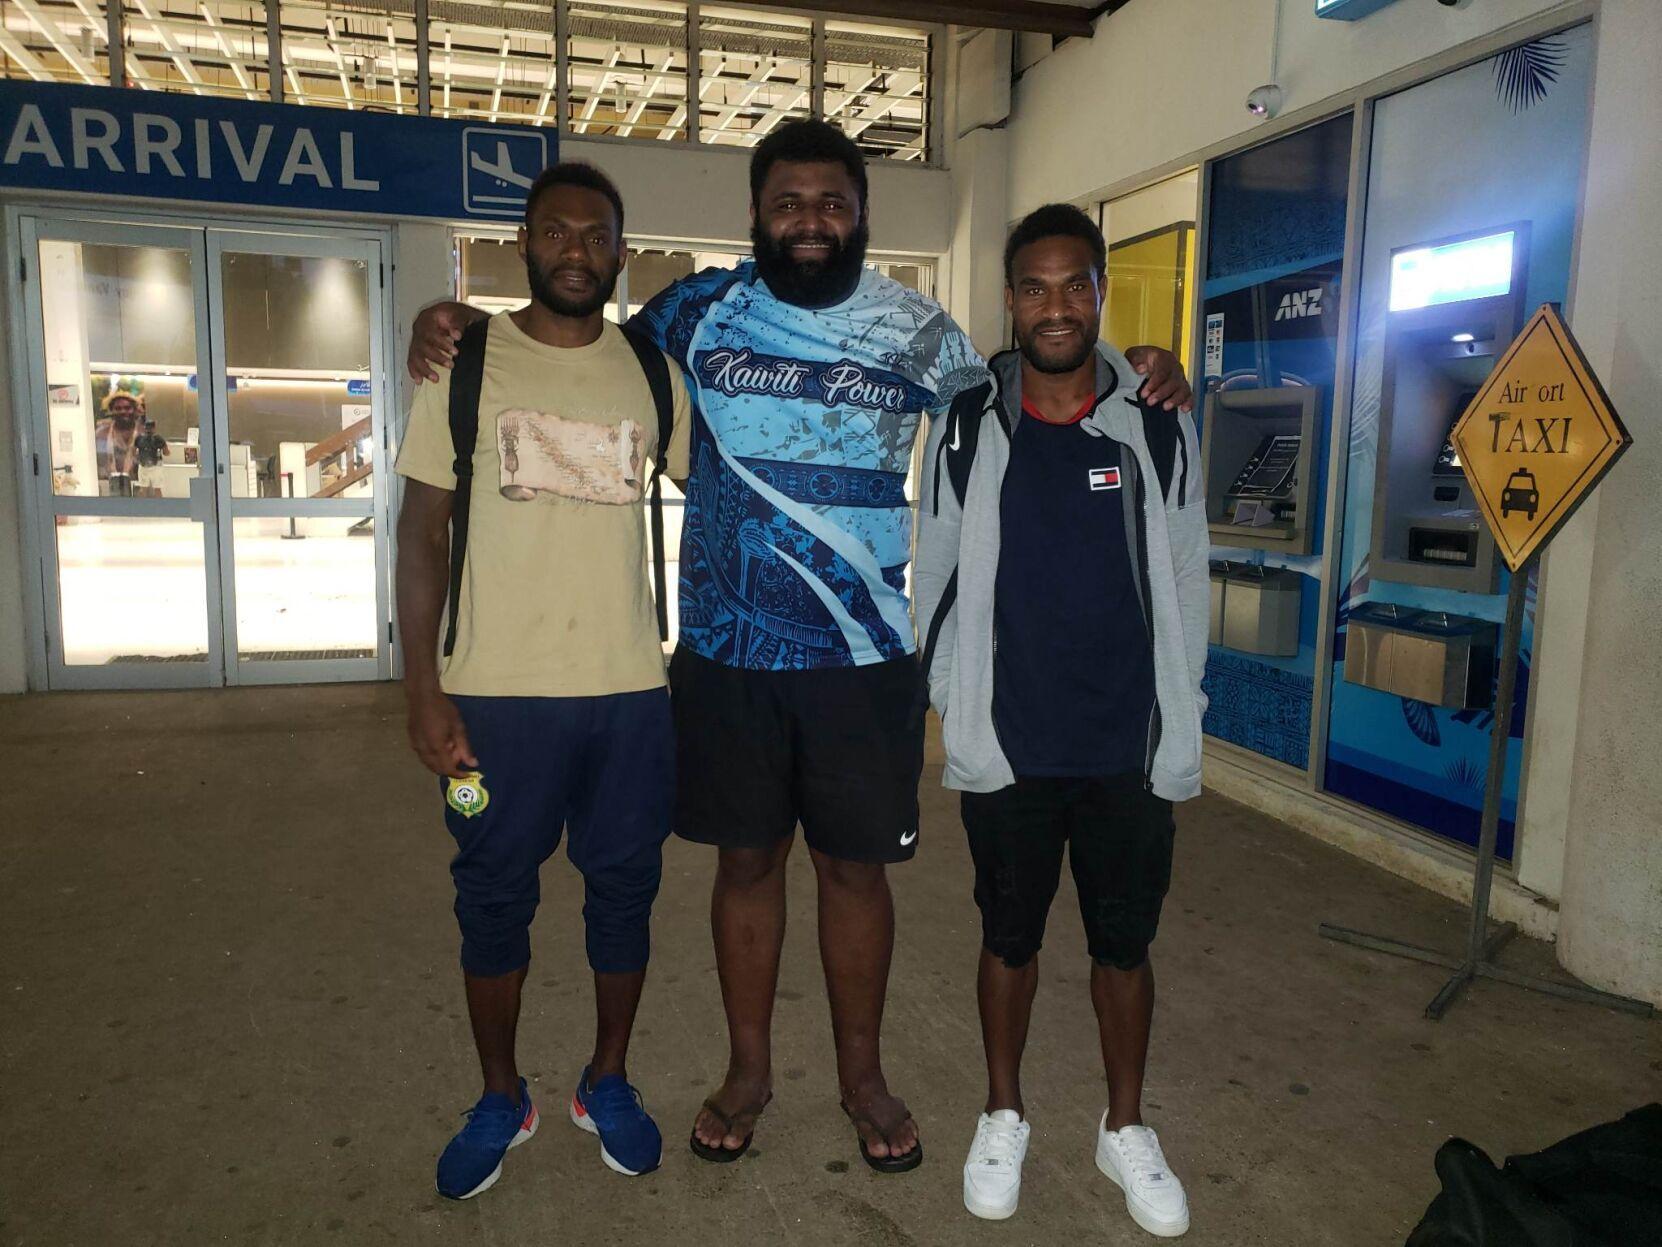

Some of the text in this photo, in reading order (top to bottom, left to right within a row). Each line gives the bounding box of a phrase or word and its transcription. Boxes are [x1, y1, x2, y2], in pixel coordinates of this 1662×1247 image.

[3, 103, 380, 192] ARRIVAL
[1274, 288, 1323, 322] ANZ
[705, 351, 904, 410] Kaiviti Power
[1488, 411, 1573, 454] TAXI
